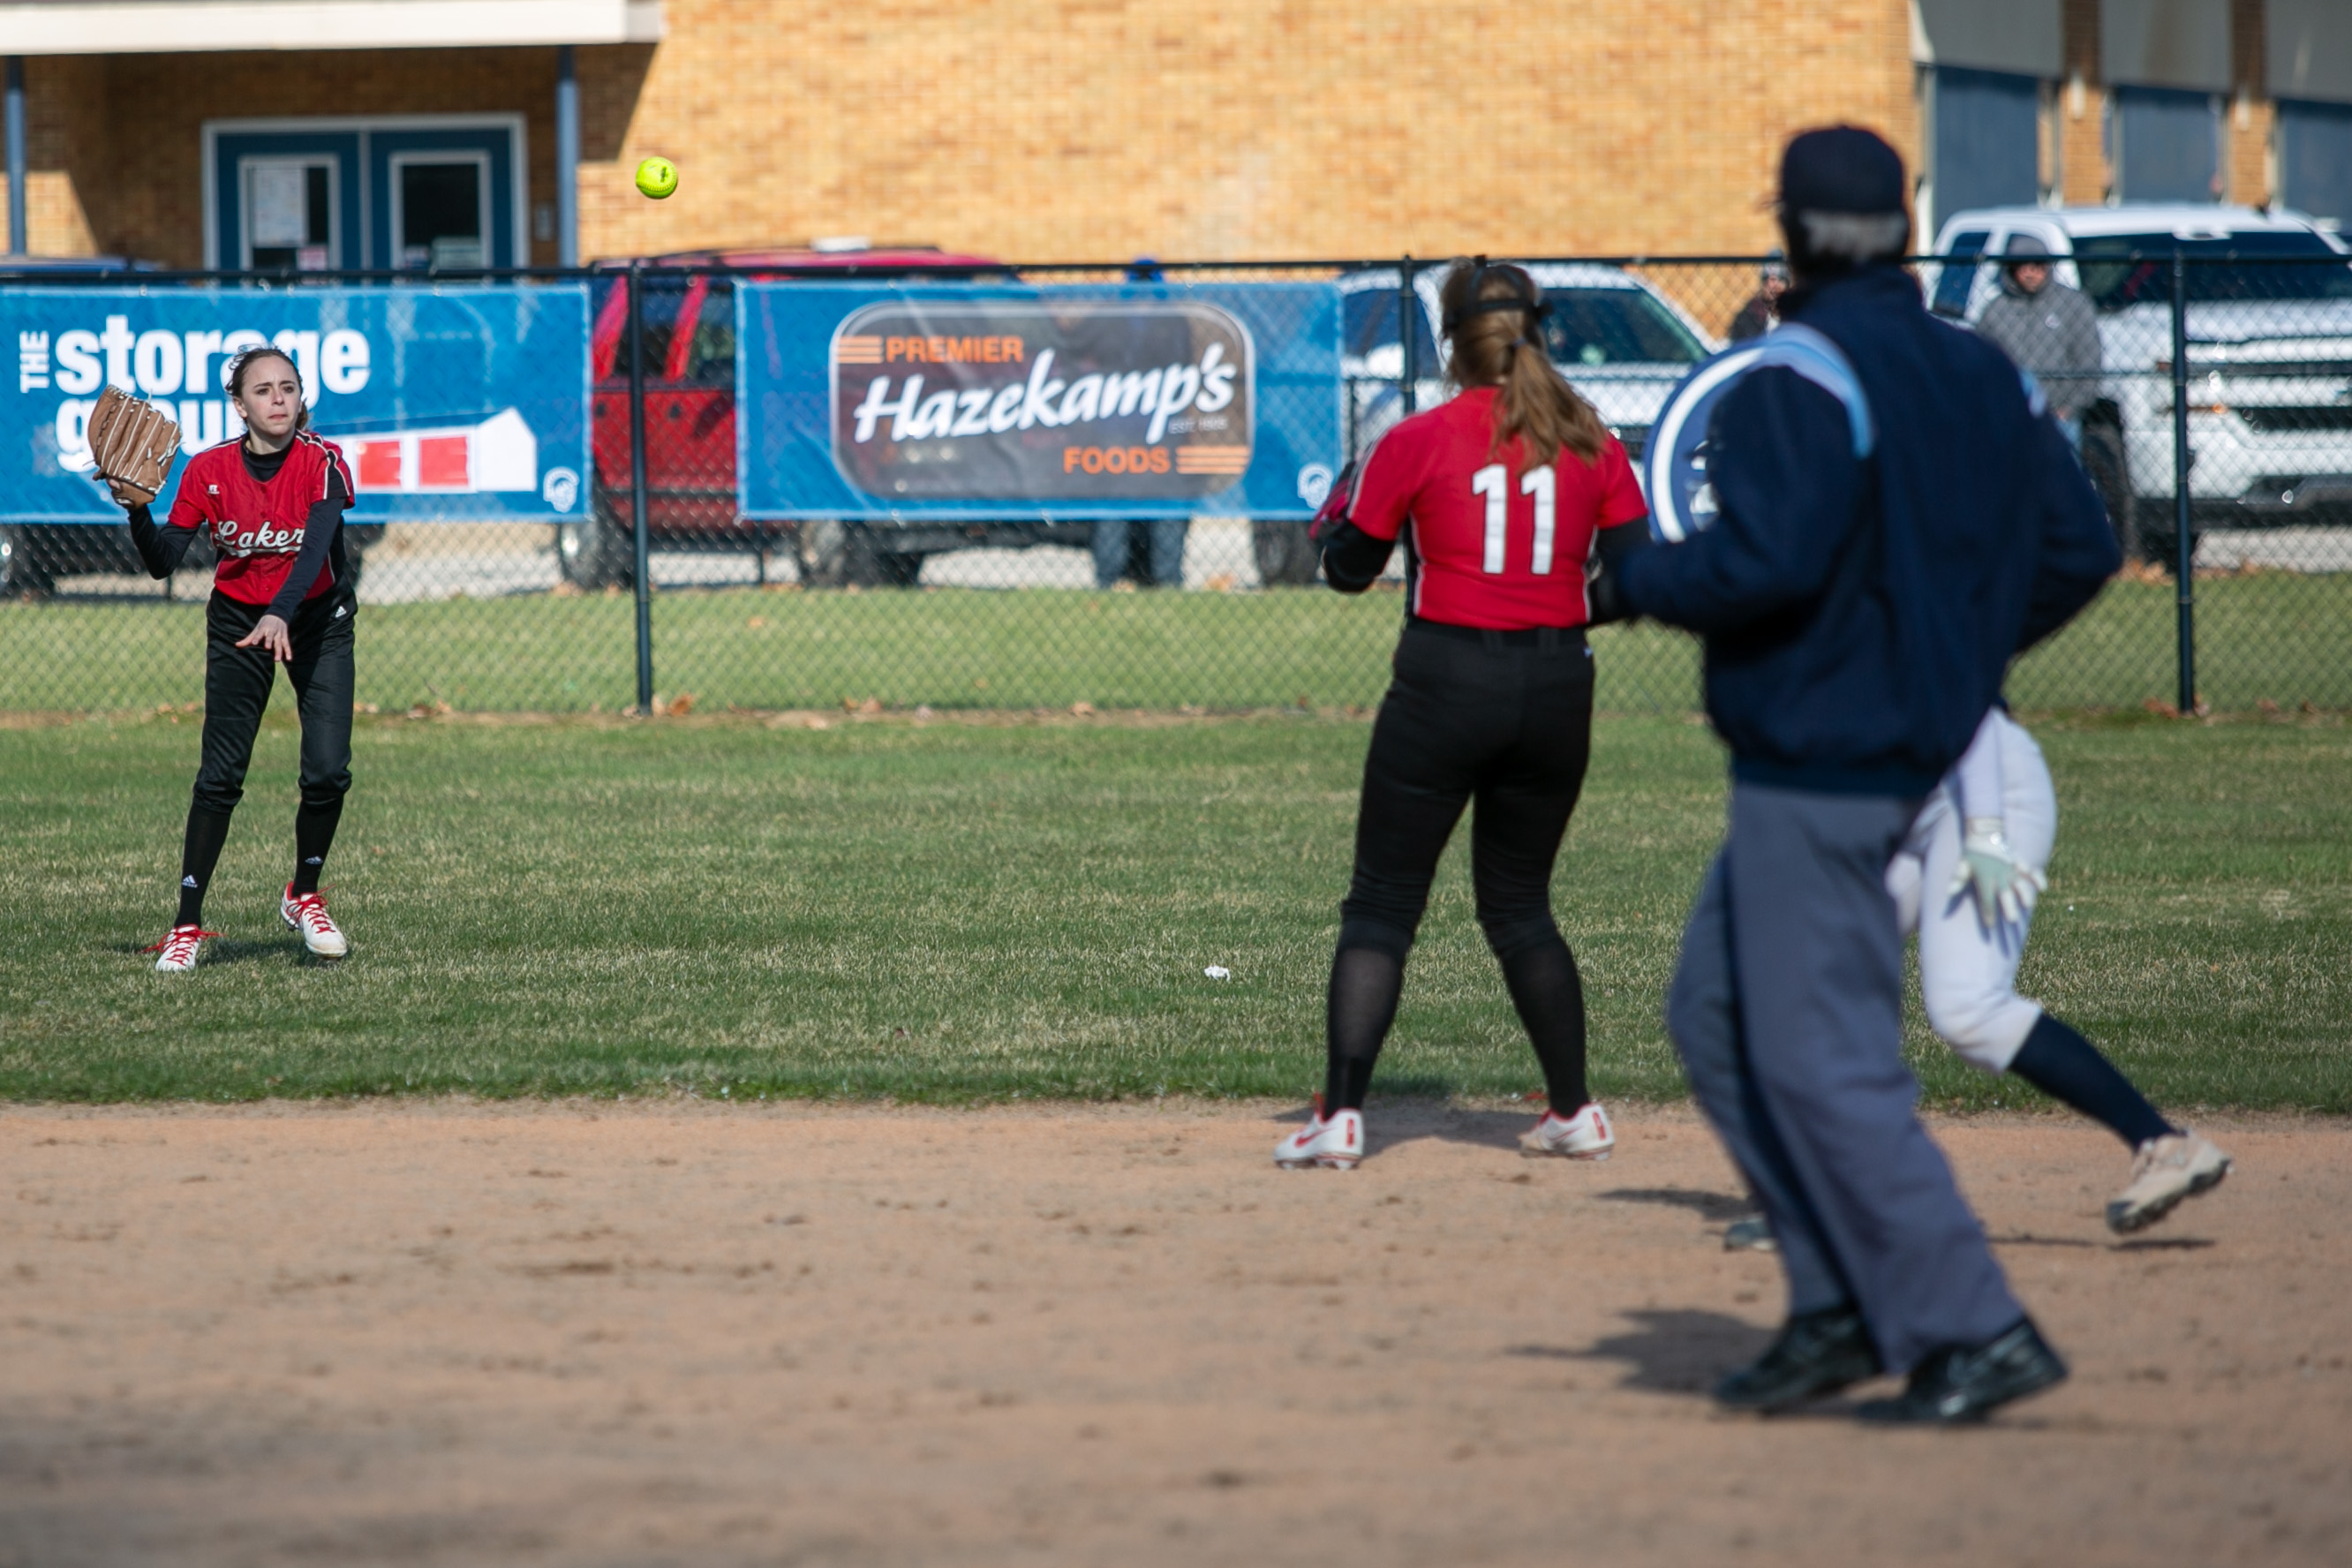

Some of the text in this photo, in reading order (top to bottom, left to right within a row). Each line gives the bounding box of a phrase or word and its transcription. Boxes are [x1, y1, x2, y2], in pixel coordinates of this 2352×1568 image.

[19, 330, 49, 393] THE
[886, 336, 1023, 363] PREMIER
[855, 342, 1235, 444] Hazekamp's
[1064, 446, 1171, 474] FOODS
[215, 520, 305, 548] Laker
[1472, 464, 1556, 576] 11
